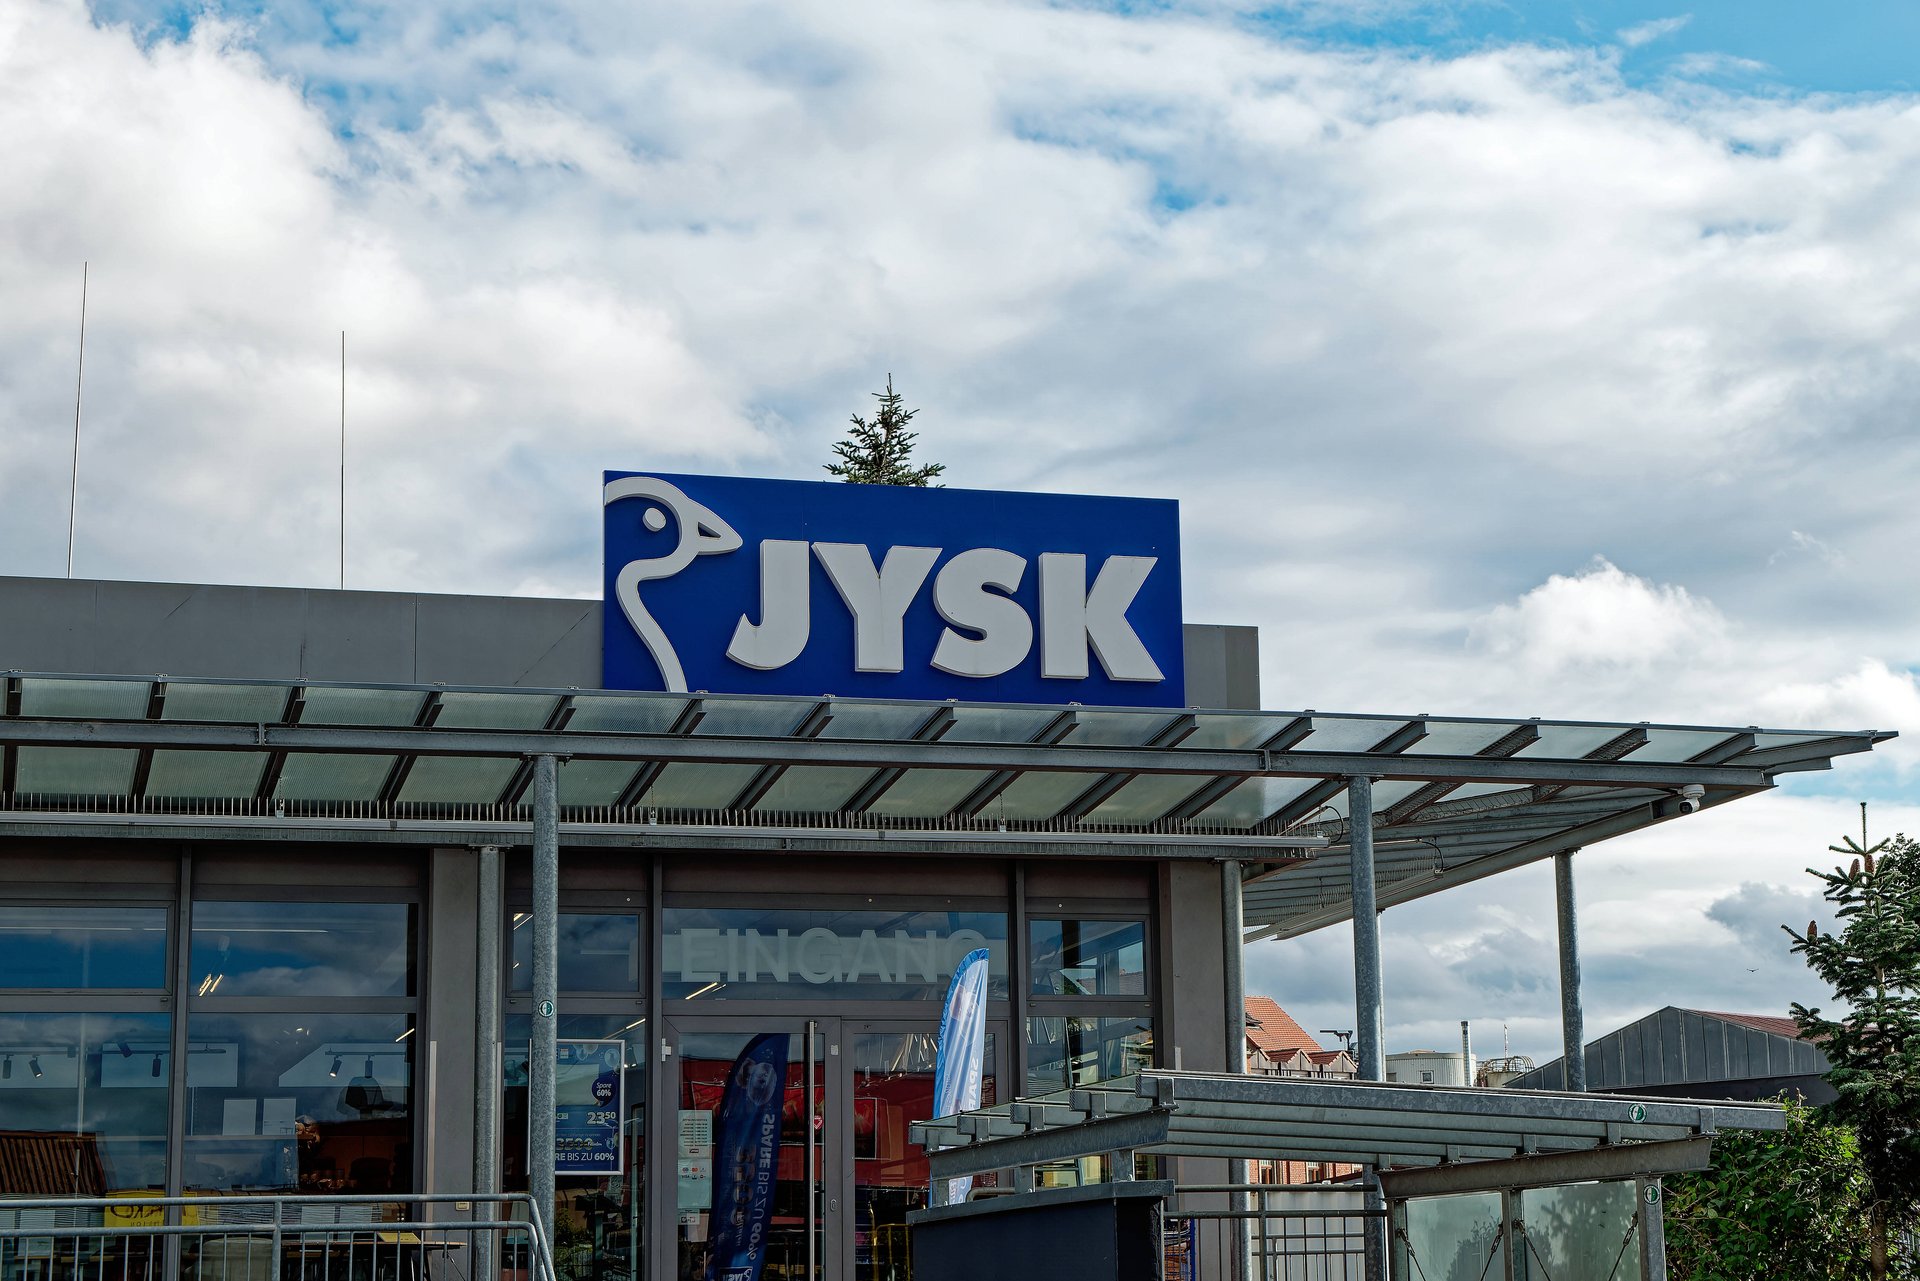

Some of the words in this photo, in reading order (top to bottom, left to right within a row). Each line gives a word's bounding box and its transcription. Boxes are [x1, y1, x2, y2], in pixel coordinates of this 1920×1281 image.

[726, 538, 1165, 683] JYSK
[596, 1089, 612, 1097] 60%
[567, 1153, 579, 1161] BIS
[581, 1153, 593, 1161] ZU
[594, 1153, 615, 1161] 60%
